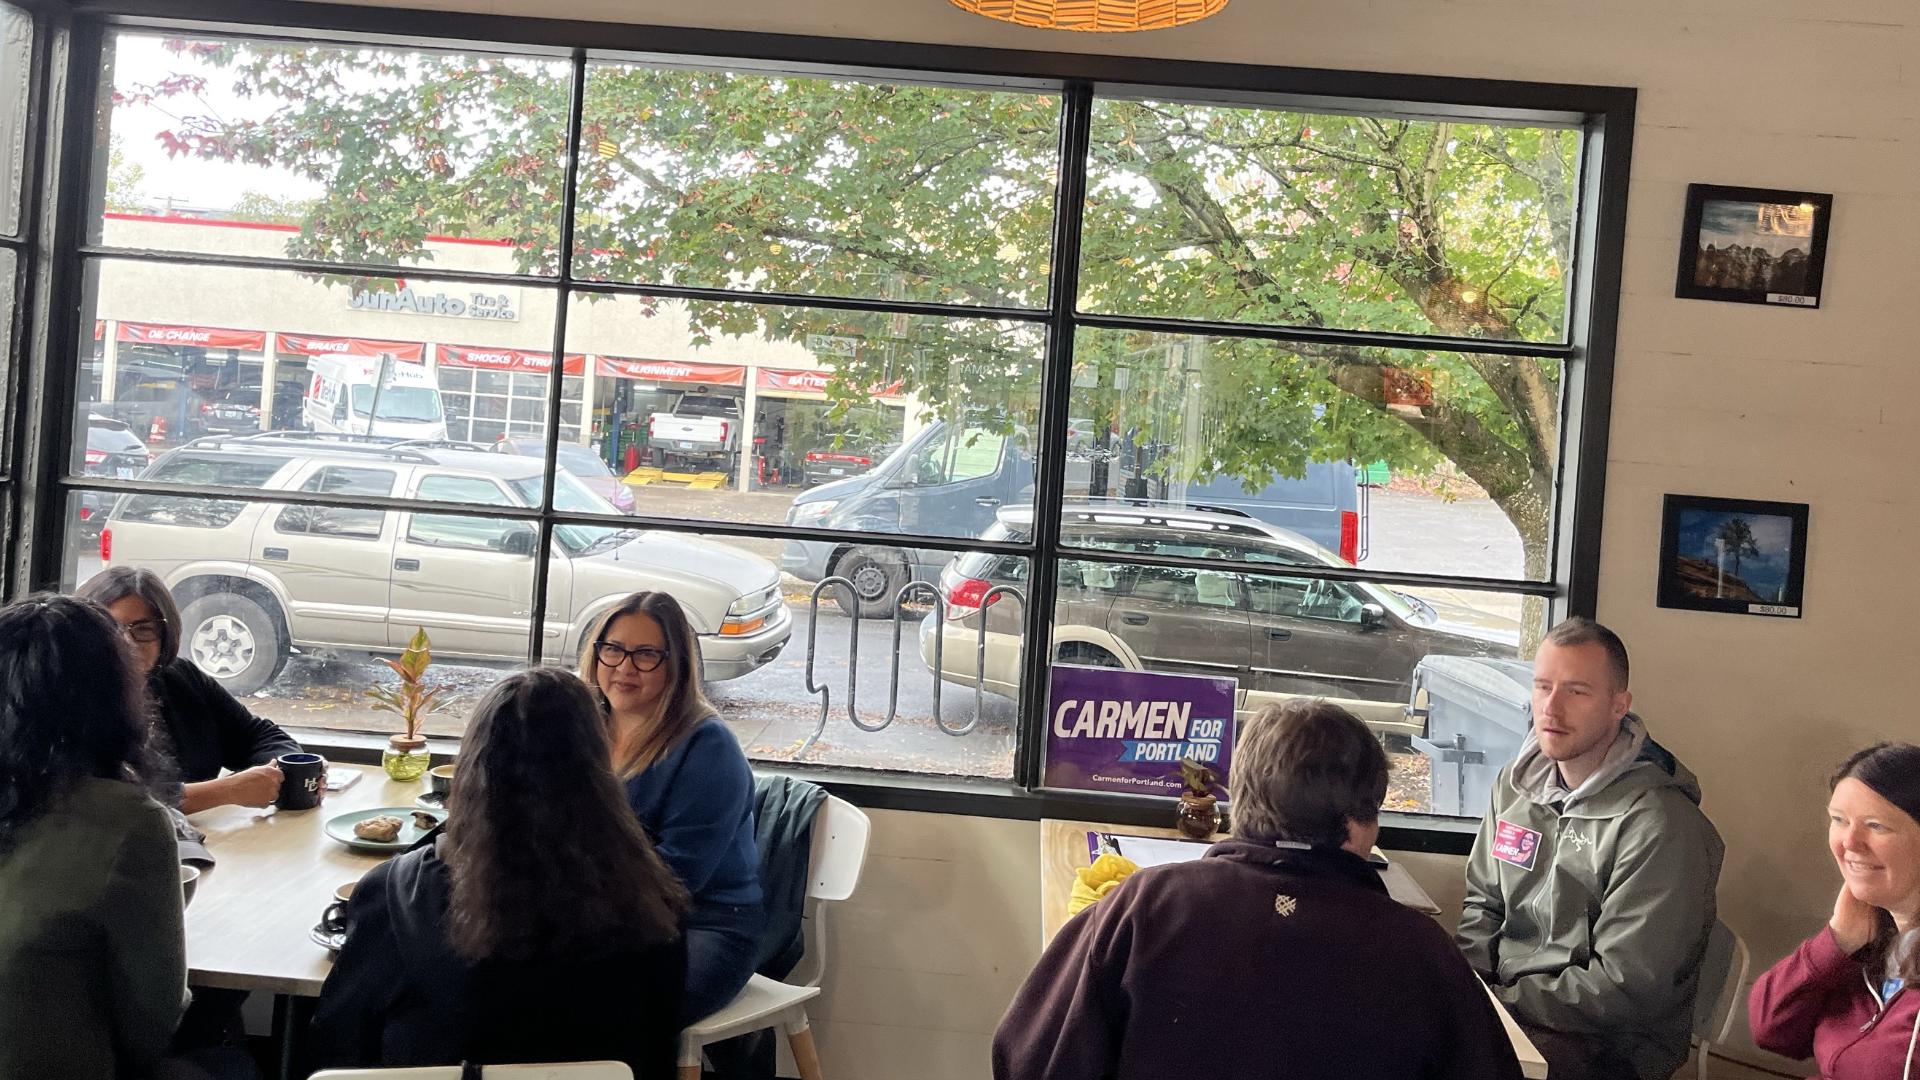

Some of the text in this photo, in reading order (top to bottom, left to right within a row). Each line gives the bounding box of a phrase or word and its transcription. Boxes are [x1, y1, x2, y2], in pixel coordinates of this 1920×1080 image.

[468, 304, 515, 320] Service
[148, 329, 210, 342] OIL CHANGE
[306, 341, 351, 352] BRAKES
[466, 352, 512, 364] SHOCKS
[522, 357, 552, 367] STRU
[626, 364, 693, 377] ALIGNMENT
[1053, 700, 1223, 739] CARMEN FOR
[1134, 742, 1217, 762] PORTLAND
[1092, 774, 1182, 789] CarmenforPortland.com
